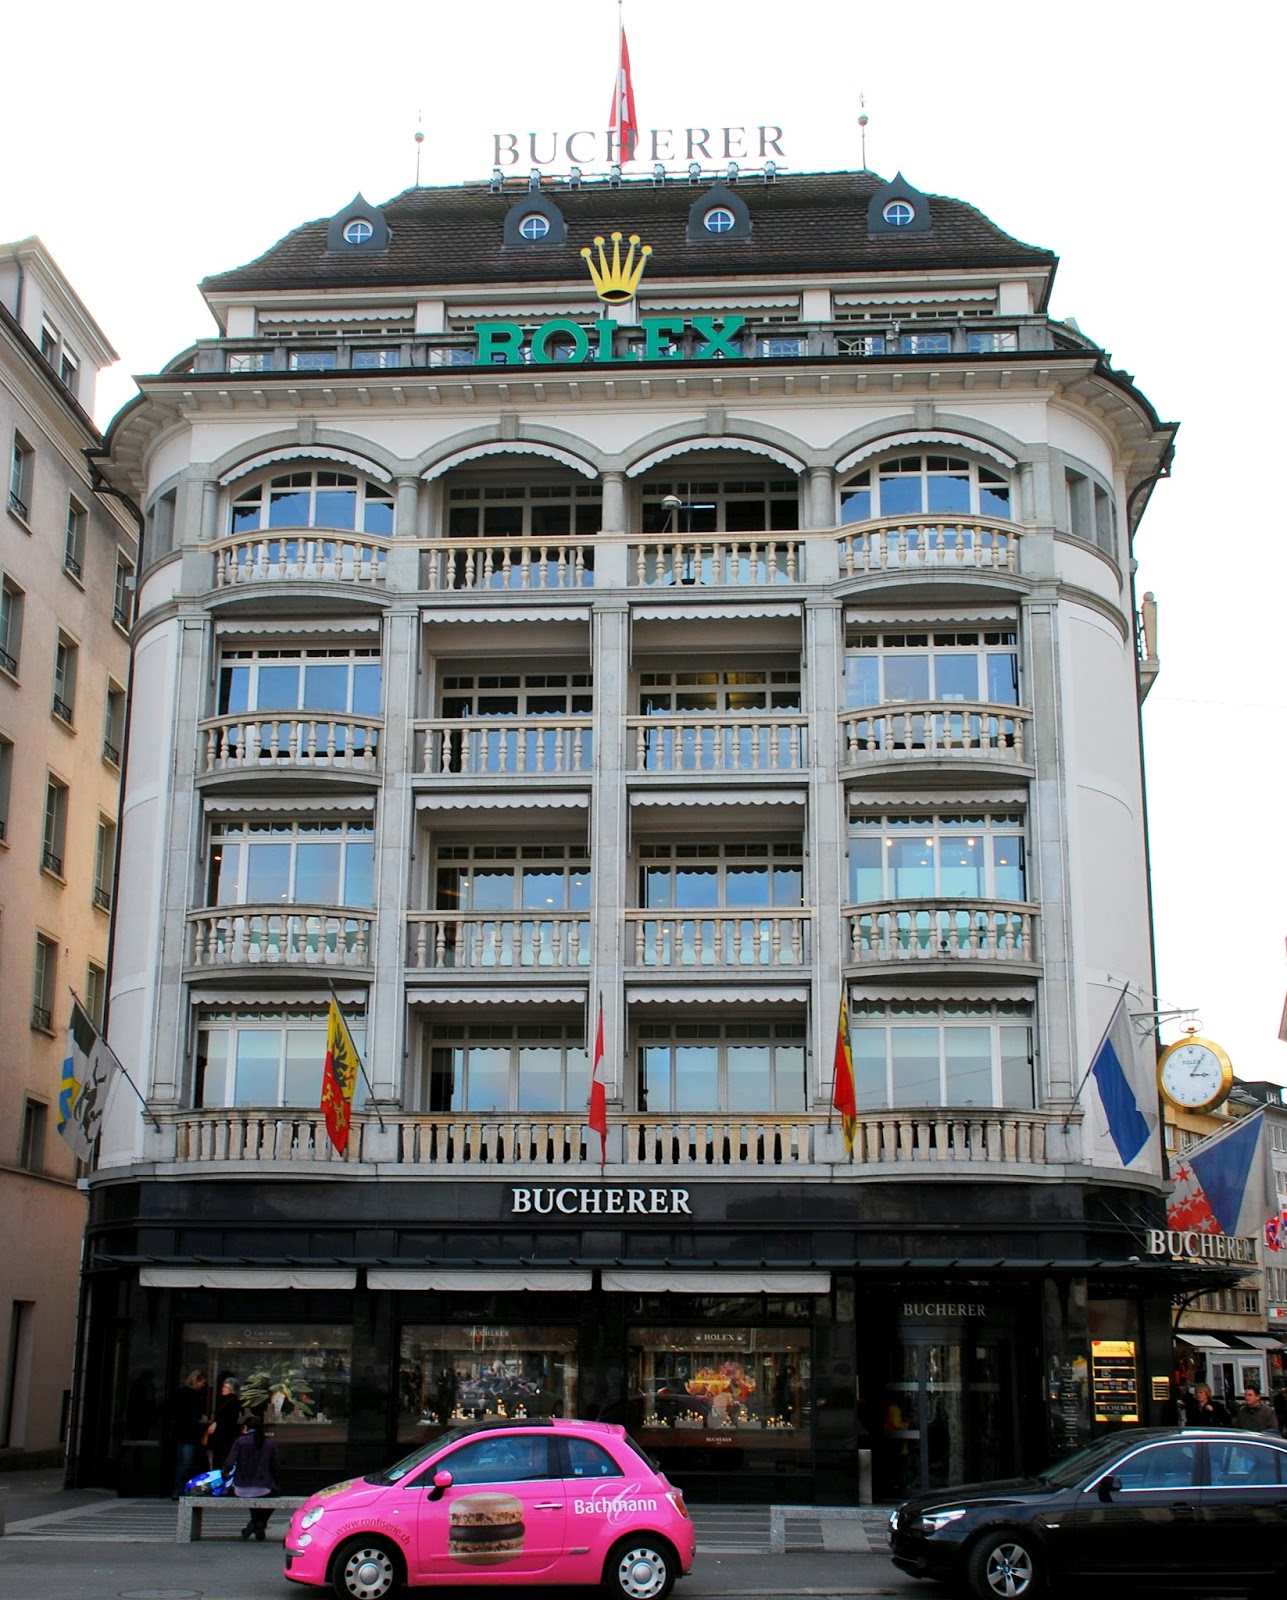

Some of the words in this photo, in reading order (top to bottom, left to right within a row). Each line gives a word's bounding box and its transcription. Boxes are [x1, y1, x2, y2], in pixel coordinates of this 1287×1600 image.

[493, 126, 786, 165] BUCHERER
[474, 315, 745, 365] ROLEX
[512, 1188, 692, 1214] BUCHERER
[1149, 1229, 1252, 1261] BUCHERER
[903, 1303, 986, 1316] BUCHERER
[574, 1496, 657, 1514] Bachmann
[335, 1518, 411, 1545] www.confiserie.ch
